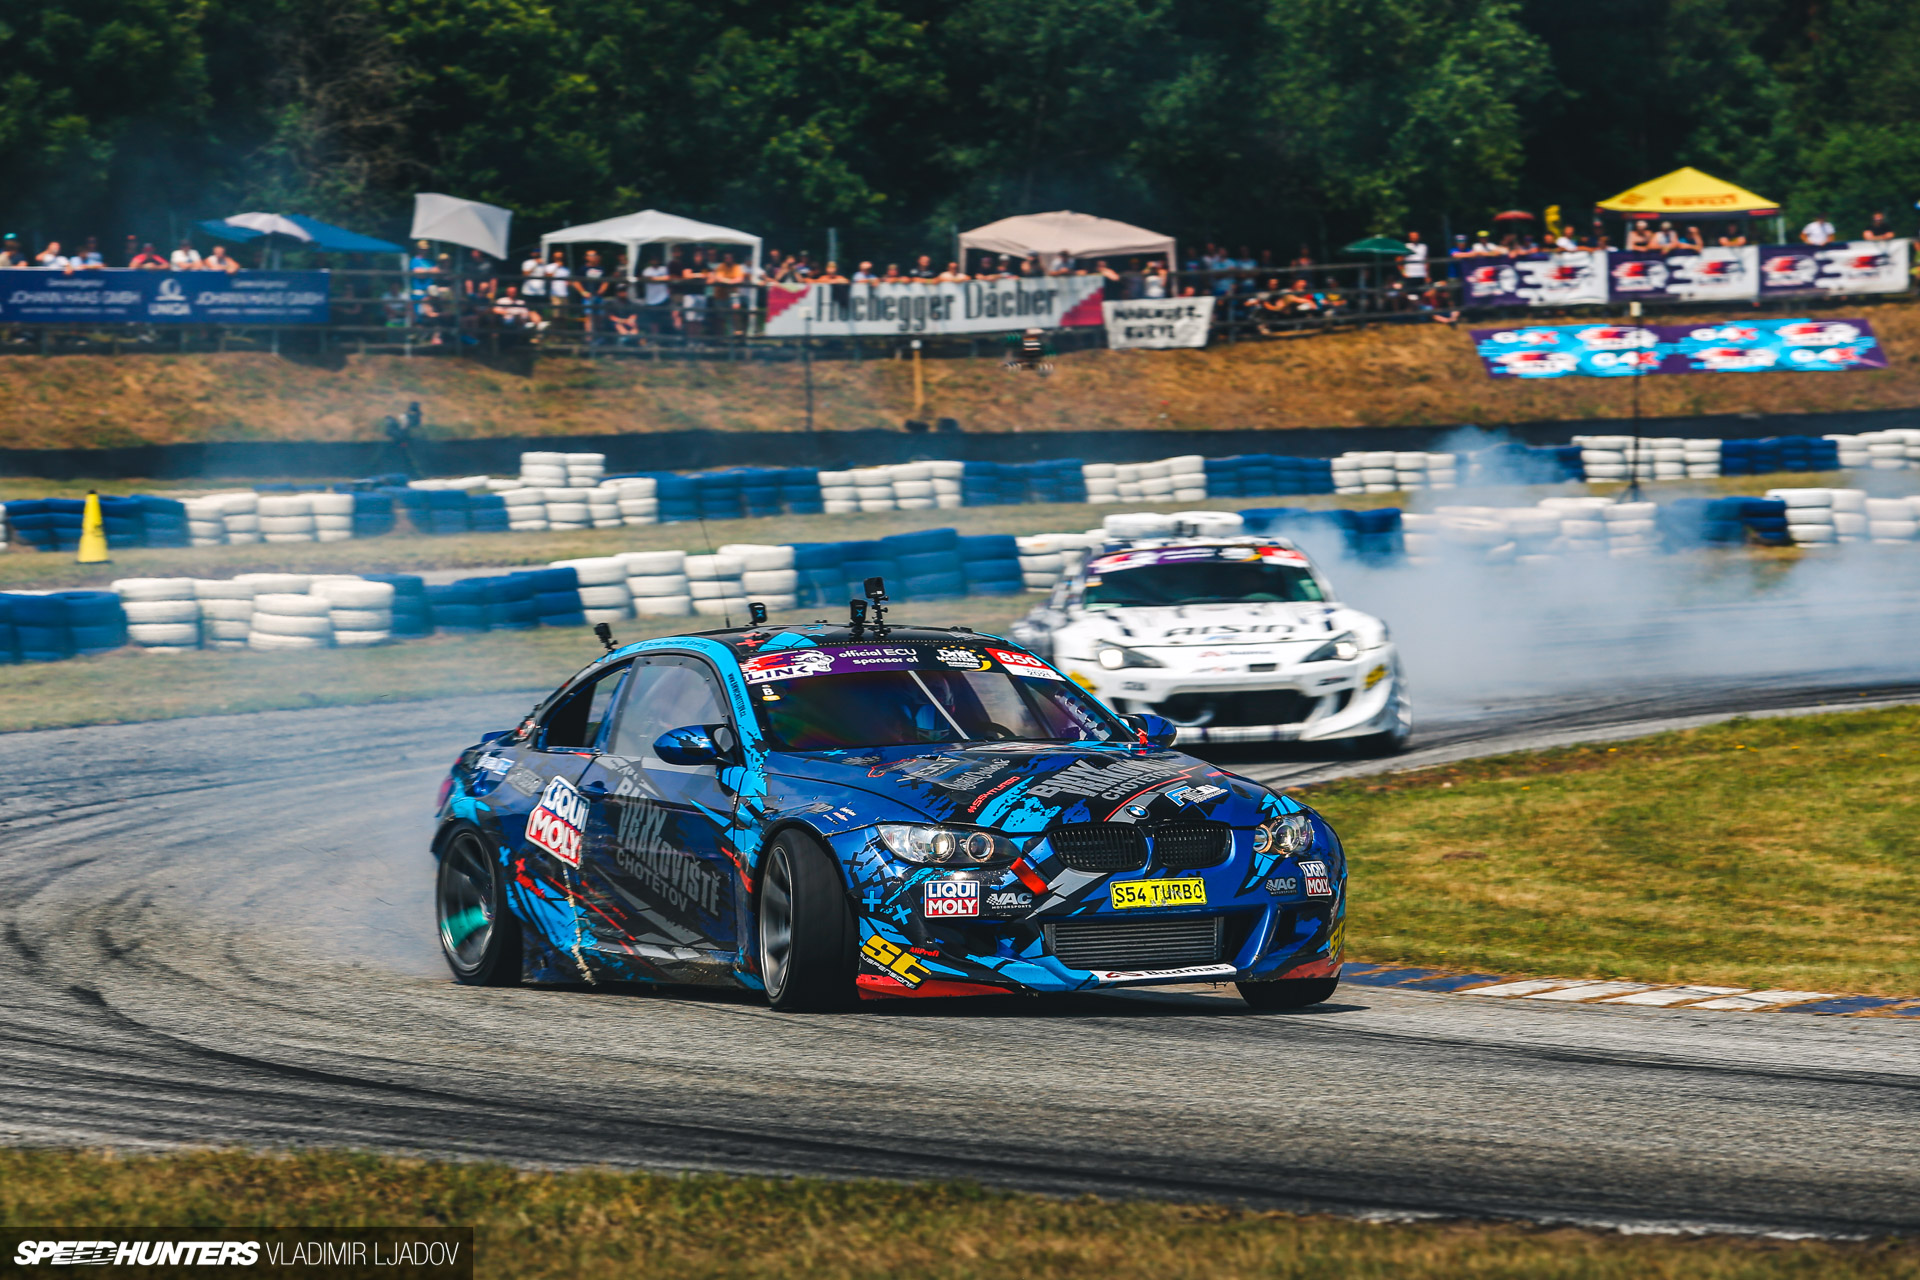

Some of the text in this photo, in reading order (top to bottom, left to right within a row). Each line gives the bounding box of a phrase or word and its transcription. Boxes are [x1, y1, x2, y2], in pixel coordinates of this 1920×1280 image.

[839, 648, 917, 658] official ECU
[997, 652, 1042, 667] 850
[852, 658, 903, 666] sponsor
[747, 665, 810, 681] LINK
[1027, 759, 1101, 798] BMW
[542, 781, 589, 833] LIQUI
[530, 809, 581, 860] MOLY
[928, 883, 977, 898] LIQUI
[1115, 880, 1202, 903] S54 TURBO
[1268, 878, 1296, 891] VAC
[1308, 879, 1329, 893] MOLY
[991, 893, 1032, 905] VAC
[928, 899, 978, 915] MOLY
